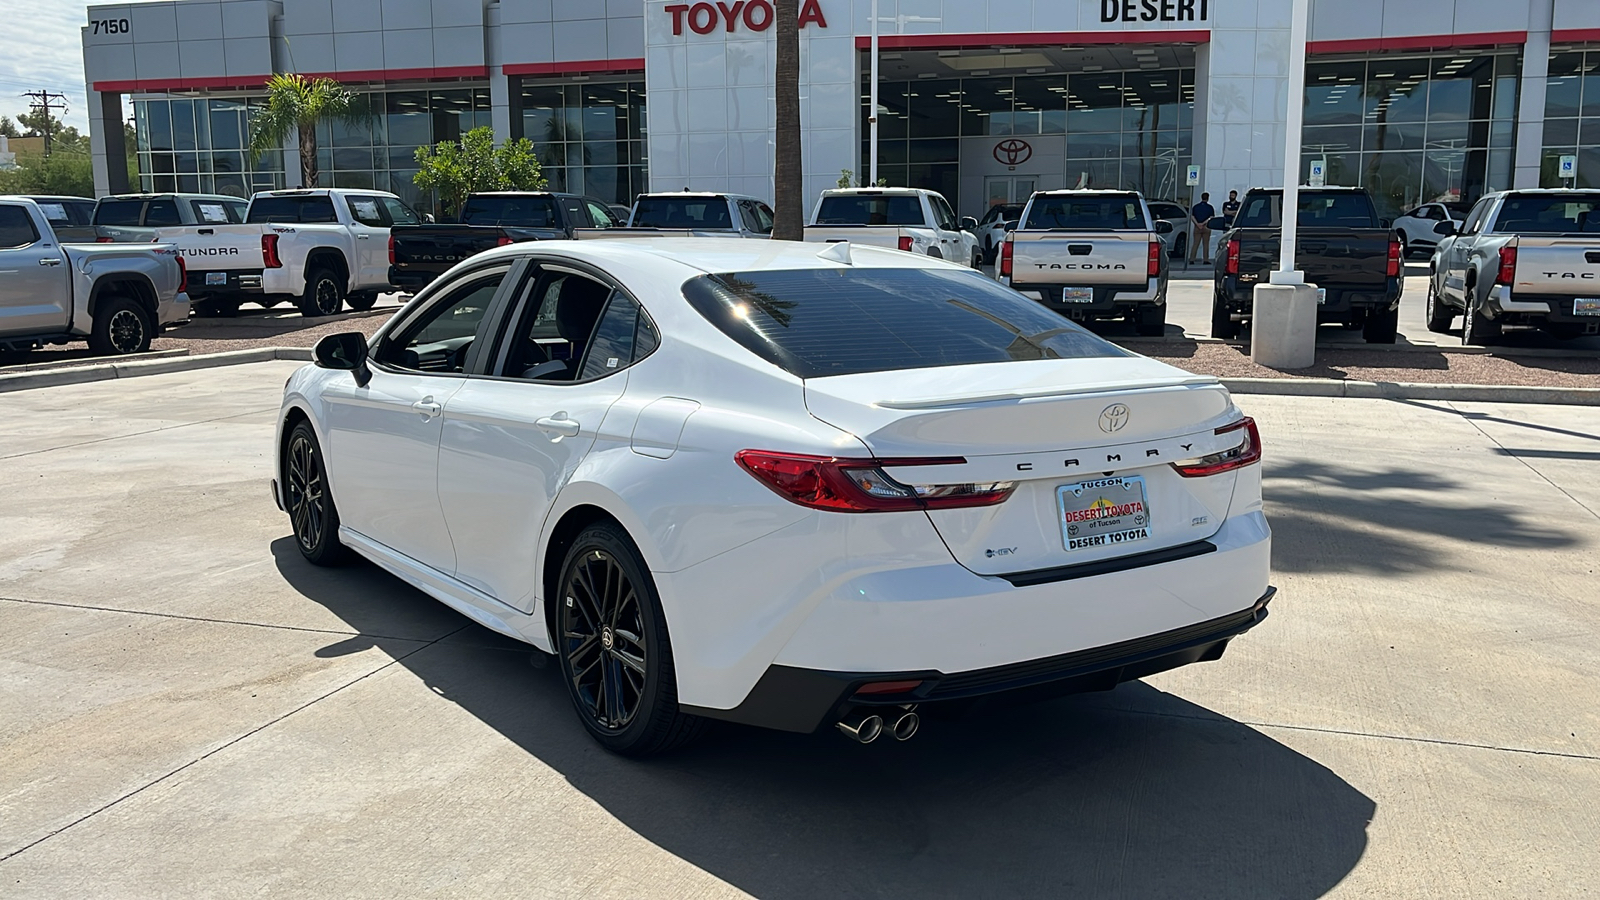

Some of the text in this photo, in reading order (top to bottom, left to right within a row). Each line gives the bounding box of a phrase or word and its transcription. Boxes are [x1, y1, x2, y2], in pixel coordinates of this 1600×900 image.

[91, 18, 130, 35] 7150
[664, 0, 828, 35] TOYOA
[179, 247, 239, 256] TUNDRA
[1016, 443, 1193, 471] CAMRY
[1081, 478, 1123, 489] TUCSON
[1066, 502, 1143, 523] DESERT TOYOTA
[1089, 519, 1121, 529] of Tucson
[1069, 528, 1148, 549] DESERT TOYOTA
